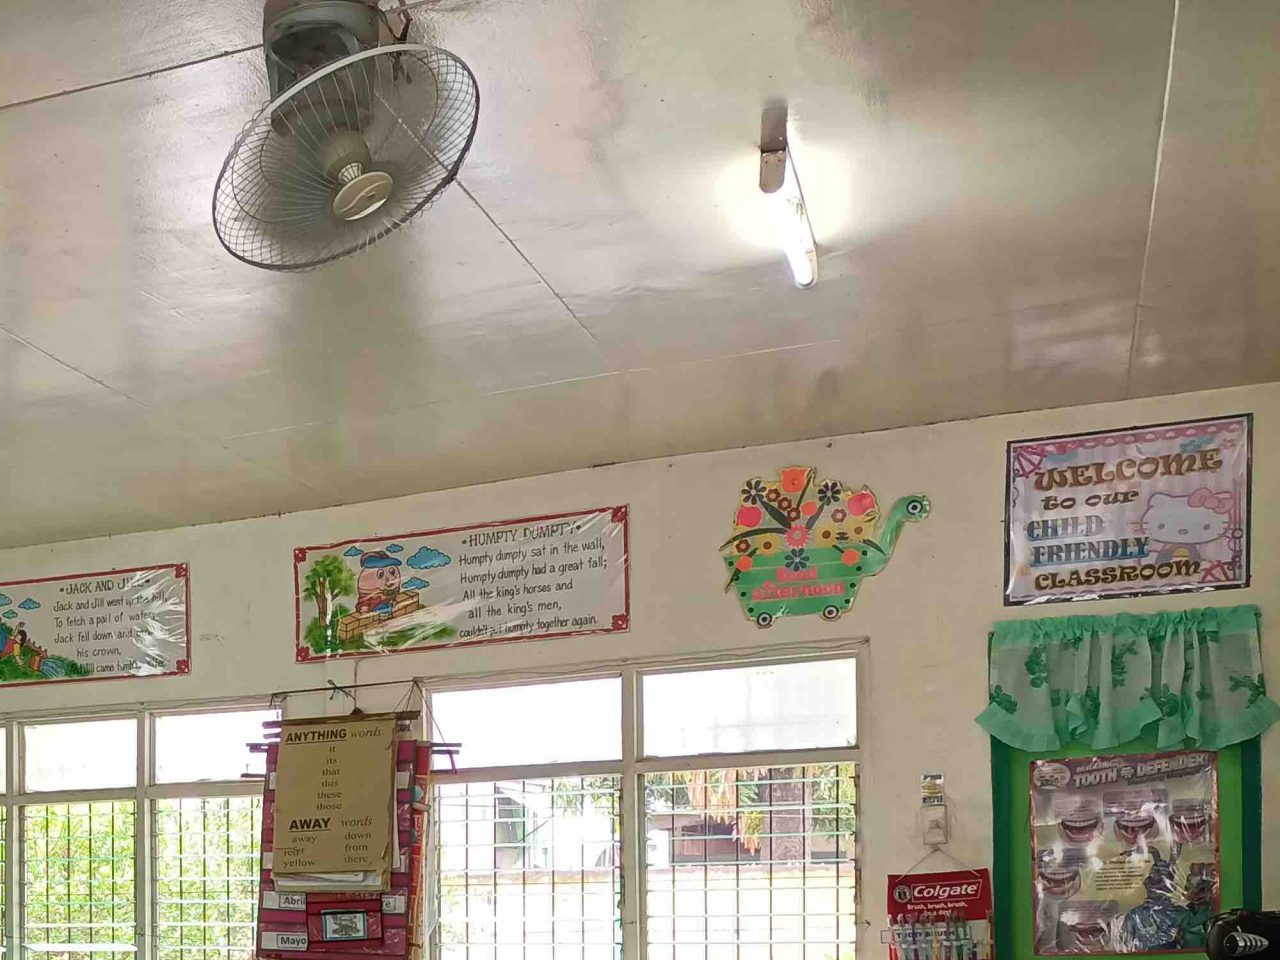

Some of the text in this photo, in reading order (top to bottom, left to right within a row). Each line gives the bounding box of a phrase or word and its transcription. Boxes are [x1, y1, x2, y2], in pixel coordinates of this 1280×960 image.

[1034, 448, 1223, 492] WELCOME
[1042, 490, 1139, 511] to our
[1026, 515, 1104, 541] CHILD
[469, 529, 518, 547] HUMPTY
[459, 551, 494, 566] Humpty
[495, 548, 527, 564] dumpty
[530, 547, 547, 558] sat
[550, 544, 559, 555] in
[563, 541, 580, 553] the
[1031, 537, 1150, 565] FRIENDLY
[460, 570, 496, 585] Humpty
[497, 566, 529, 581] dumpty
[531, 562, 547, 575] had
[549, 565, 555, 574] a
[558, 558, 584, 576] great
[1034, 559, 1201, 590] CLASSROOM
[66, 579, 114, 595] JACK AND
[463, 578, 573, 601] All the king's horses and
[53, 595, 123, 612] Jack and Jill went
[468, 606, 481, 620] all
[486, 605, 502, 617] the
[507, 601, 533, 617] king's
[54, 616, 63, 628] To
[66, 615, 86, 626] fetch
[96, 613, 111, 628] pail
[114, 612, 123, 623] of
[537, 616, 569, 631] together
[54, 632, 74, 644] Jack
[77, 631, 90, 643] fell
[92, 631, 114, 641] down
[76, 648, 89, 658] his
[96, 663, 115, 673] came
[285, 727, 382, 743] ANYTHING words
[322, 768, 341, 776] that
[1072, 767, 1118, 789] TOOTH
[321, 779, 339, 788] this
[317, 791, 343, 799] these
[316, 803, 343, 811] those
[289, 816, 373, 831] AWAY words
[292, 835, 318, 844] away
[344, 832, 372, 841] down
[344, 844, 368, 852] from
[283, 858, 317, 869] yellow
[344, 855, 369, 863] there
[913, 884, 978, 899] Colgate
[280, 936, 307, 946] Mayo
